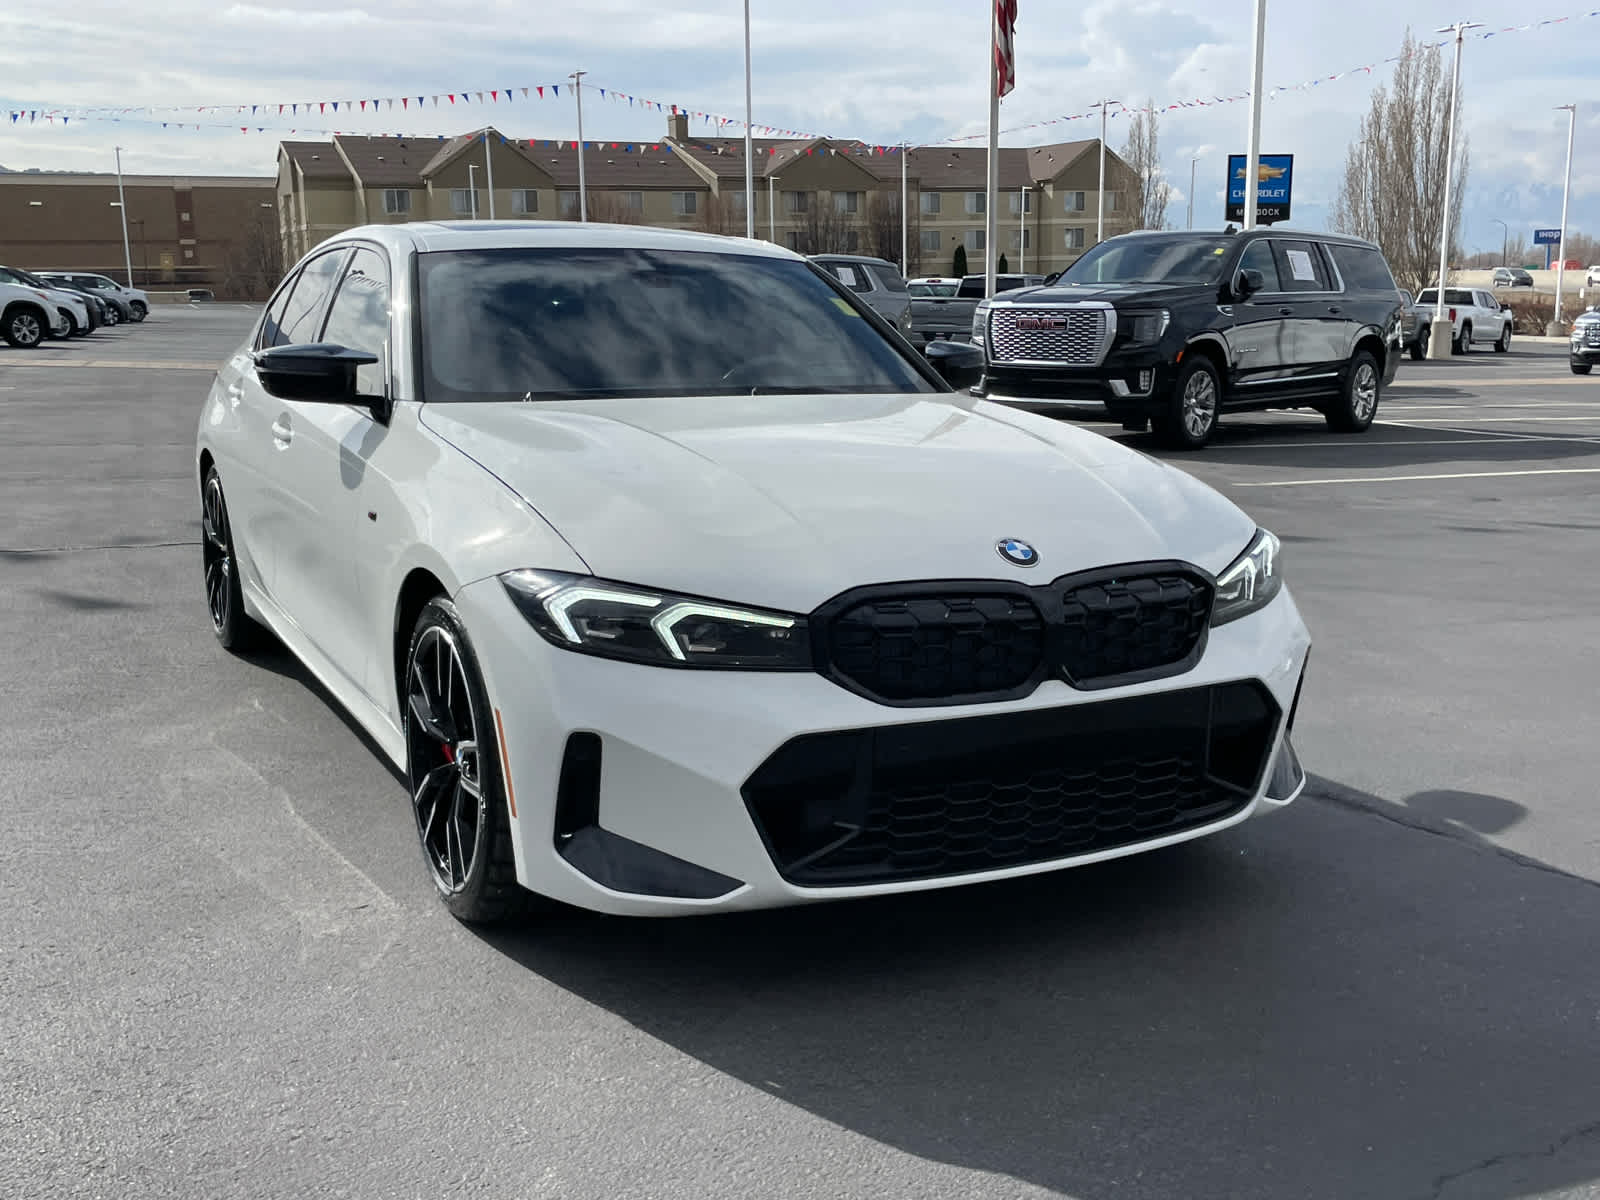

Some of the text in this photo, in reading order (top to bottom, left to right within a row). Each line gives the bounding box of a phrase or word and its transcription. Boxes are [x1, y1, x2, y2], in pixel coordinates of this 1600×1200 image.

[1232, 190, 1285, 198] CHROLET
[1236, 208, 1280, 216] MDOCK
[1017, 319, 1066, 330] GMC
